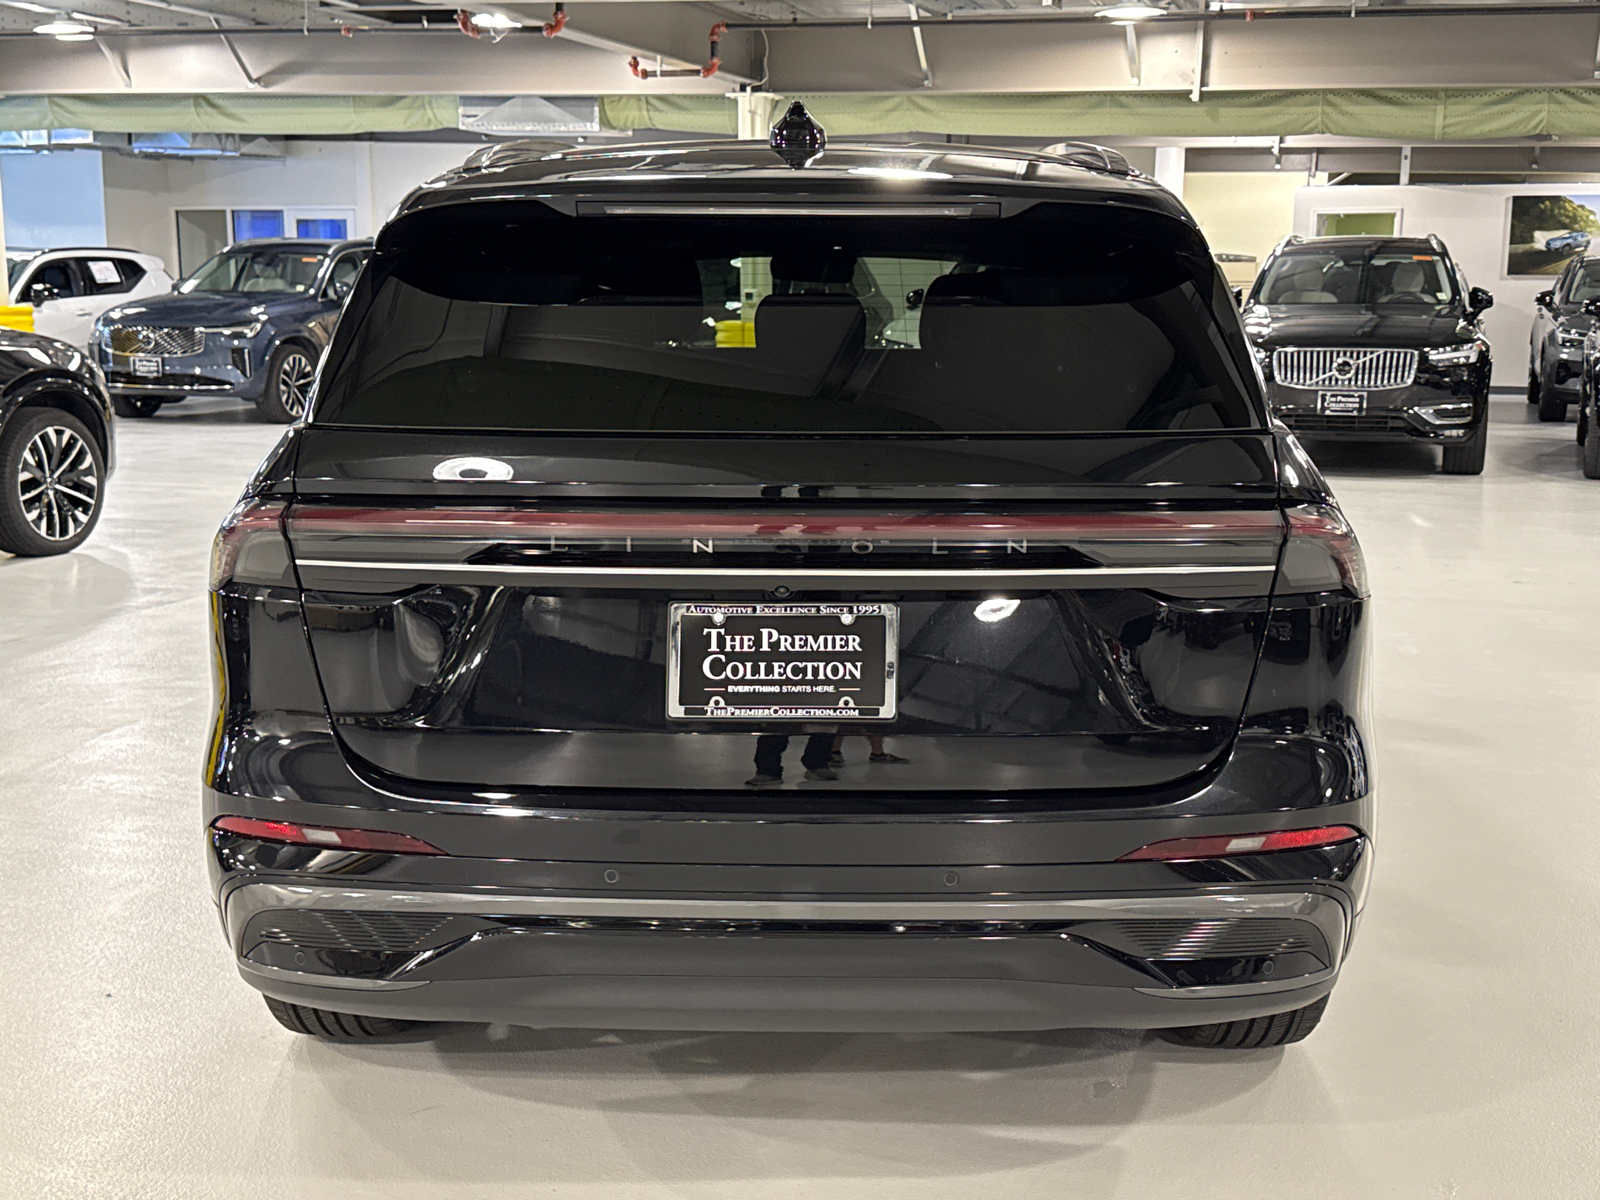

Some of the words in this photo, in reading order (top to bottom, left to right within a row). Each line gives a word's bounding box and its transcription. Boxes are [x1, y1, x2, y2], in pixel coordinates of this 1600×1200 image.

[852, 605, 880, 614] 1995
[703, 628, 755, 651] THE
[760, 628, 862, 651] PREMIER
[702, 655, 862, 680] COLLECTION
